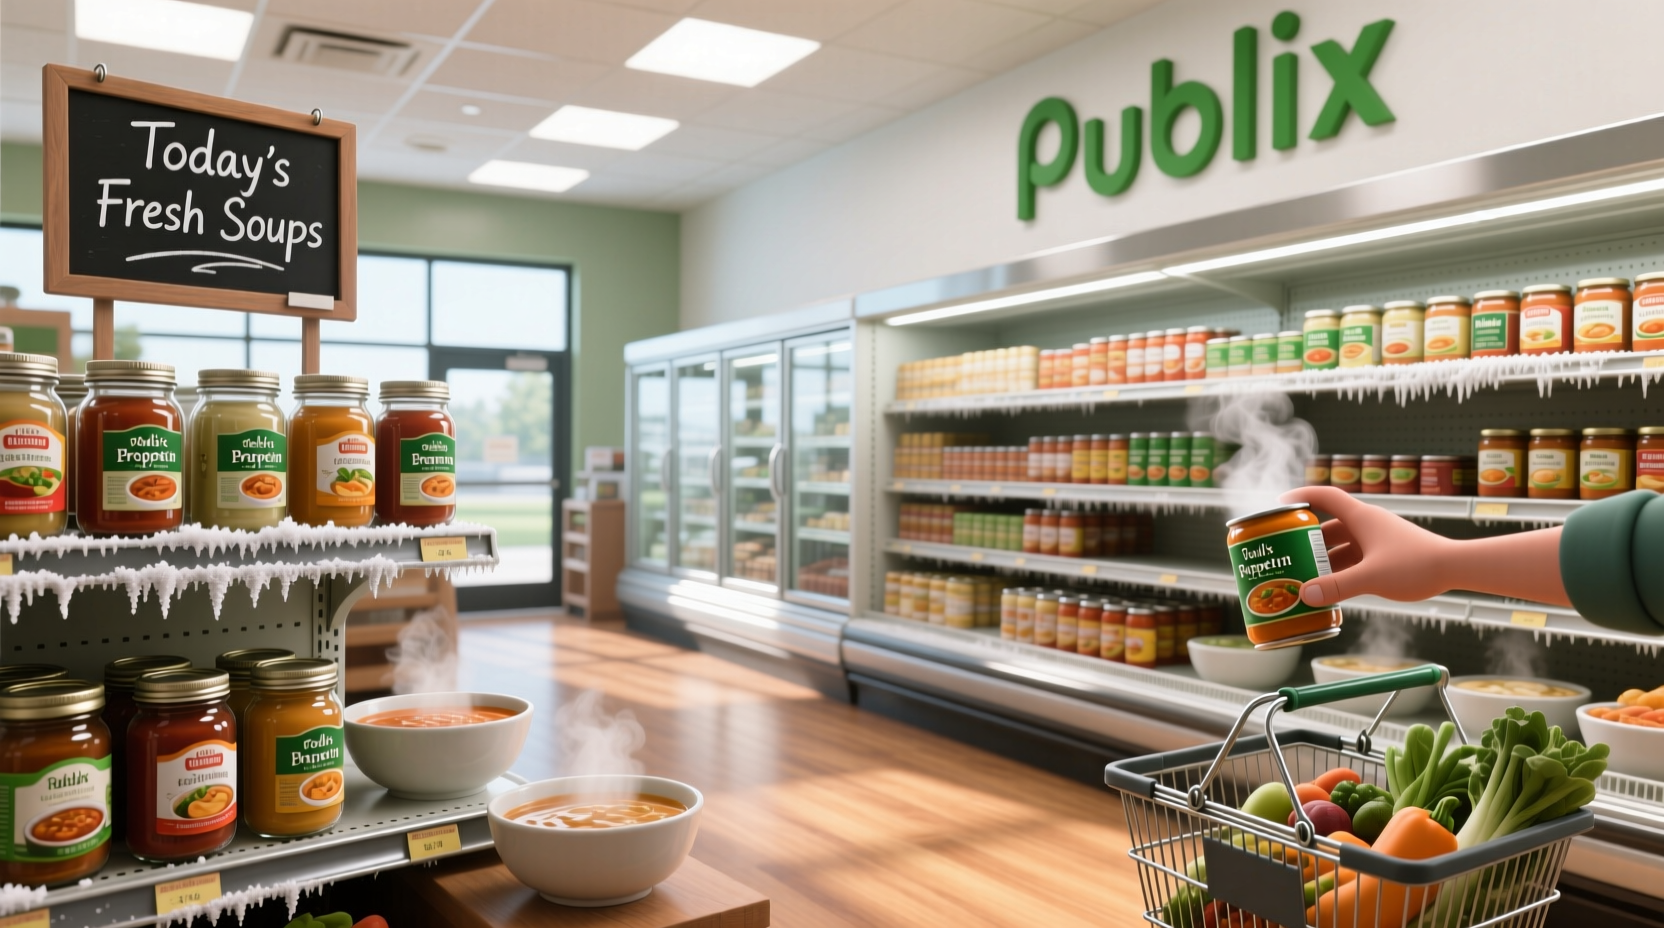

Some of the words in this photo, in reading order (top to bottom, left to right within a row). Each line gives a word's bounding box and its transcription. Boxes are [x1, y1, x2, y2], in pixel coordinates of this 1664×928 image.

[131, 121, 290, 197] Today's
[97, 178, 204, 235] Fresh
[220, 196, 323, 263] Soups
